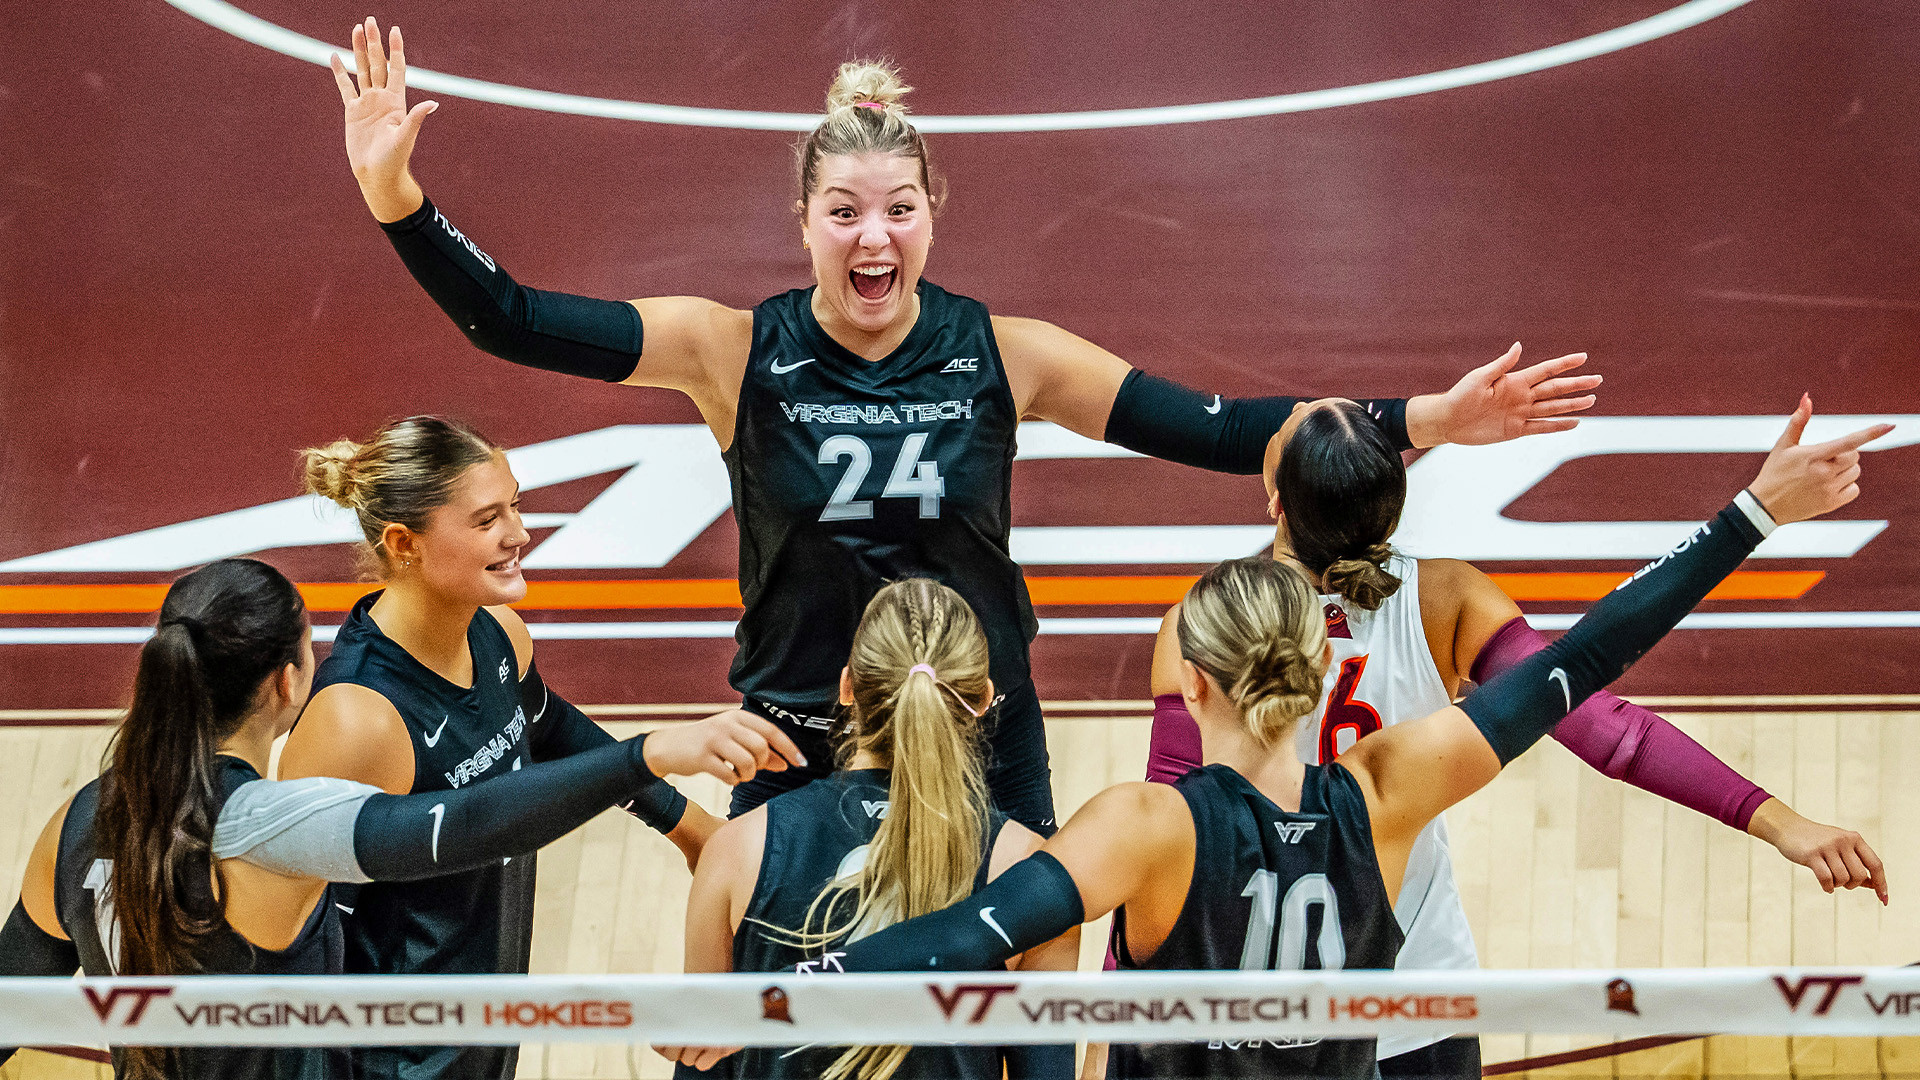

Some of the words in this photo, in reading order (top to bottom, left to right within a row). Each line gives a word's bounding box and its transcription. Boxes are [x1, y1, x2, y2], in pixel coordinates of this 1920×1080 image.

[941, 357, 979, 373] ACC
[779, 401, 901, 425] VIRGINIA
[900, 399, 974, 424] TECH
[818, 432, 946, 523] 24
[1318, 653, 1383, 767] 6
[444, 733, 512, 790] VIRGNIA
[503, 704, 527, 746] TEH
[1273, 821, 1317, 844] VT
[1239, 868, 1346, 971] 10
[82, 985, 174, 1027] VT
[174, 1002, 352, 1027] VIRGINIA
[356, 1002, 464, 1027] TECH
[483, 1001, 633, 1028] HOKIES
[926, 983, 1019, 1024] VT
[1018, 999, 1196, 1023] VIRGINIA
[1202, 997, 1310, 1022] TECH
[1327, 996, 1480, 1020] HOKIES
[1772, 975, 1864, 1017] VT
